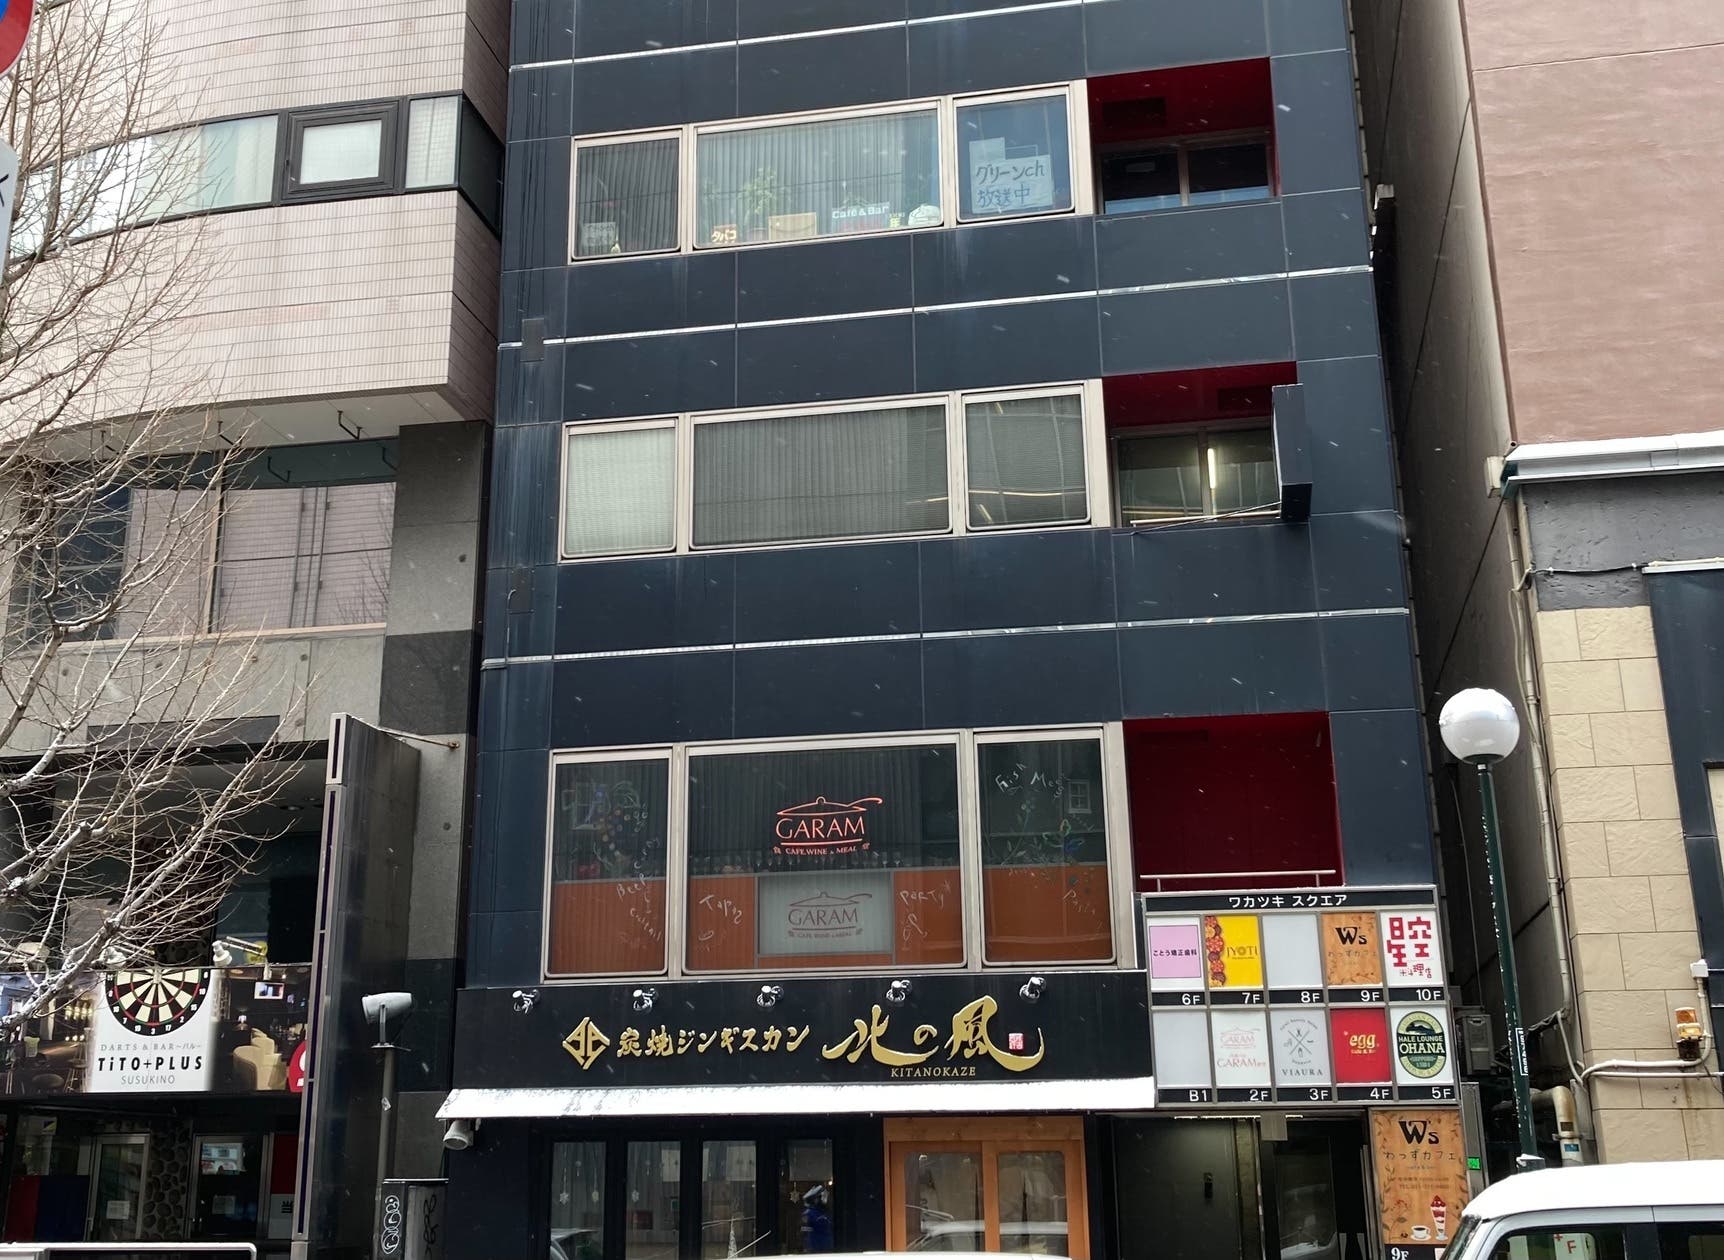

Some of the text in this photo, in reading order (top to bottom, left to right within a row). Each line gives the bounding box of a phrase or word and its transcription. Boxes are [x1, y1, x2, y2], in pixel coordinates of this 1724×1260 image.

[976, 160, 1045, 185] グリーンch
[711, 228, 737, 242] タバコ
[775, 816, 865, 839] GARAM
[1229, 894, 1347, 908] ワカツキ スクエア
[788, 908, 858, 926] GARAM
[1226, 946, 1258, 958] JYOTI
[1181, 993, 1200, 1005] 6F
[1242, 992, 1260, 1004] 7F
[1300, 991, 1320, 1003] 8F
[1360, 990, 1380, 1002] 9F
[1416, 989, 1441, 1001] 10F
[616, 995, 1045, 1072] 炭焼ジンギスカン 北の風
[1349, 1033, 1376, 1049] egg
[1400, 1042, 1445, 1054] OHANA
[891, 1067, 976, 1078] KITANOKAZE
[1281, 1068, 1323, 1077] VIAURA
[121, 1075, 175, 1085] SUSUKINO
[1189, 1090, 1207, 1102] B1
[1250, 1089, 1269, 1101] 2F
[1309, 1088, 1328, 1100] 3F
[1370, 1087, 1390, 1099] 4F
[1432, 1087, 1451, 1099] 5F
[1383, 1150, 1457, 1161] わっずカフェ
[1391, 1247, 1409, 1260] 9F
